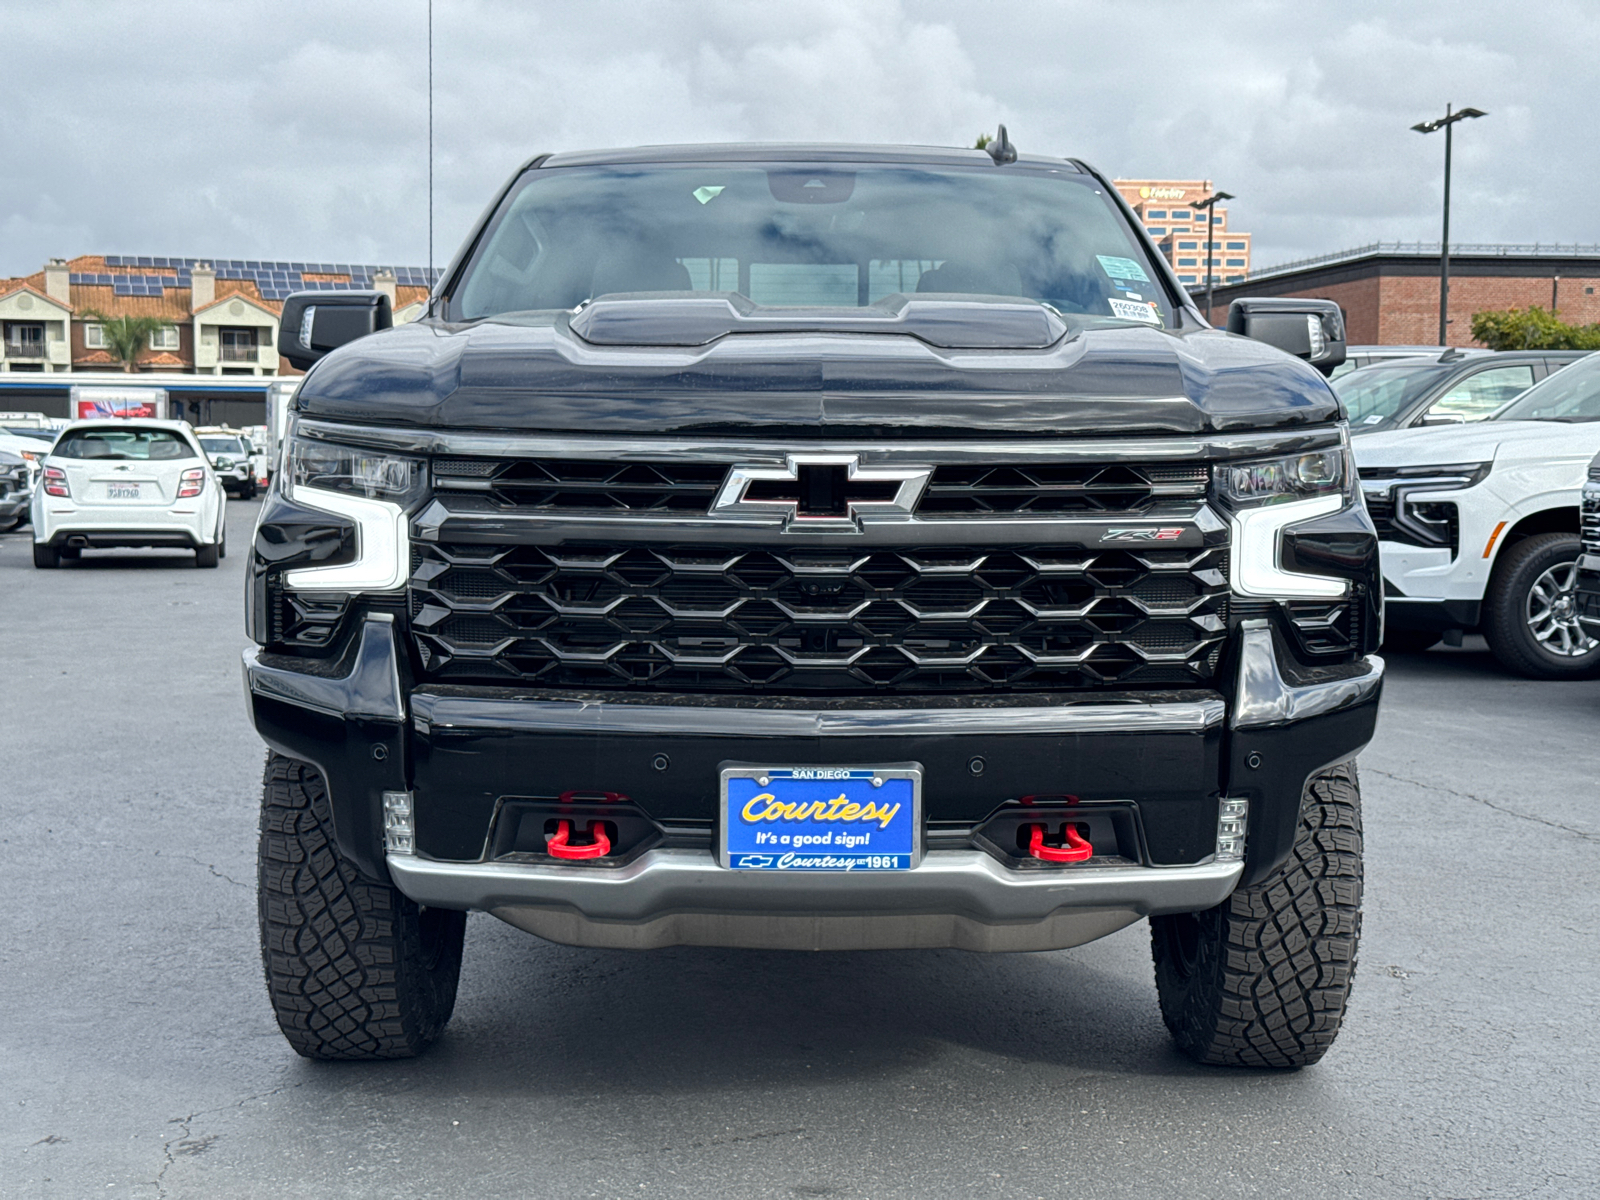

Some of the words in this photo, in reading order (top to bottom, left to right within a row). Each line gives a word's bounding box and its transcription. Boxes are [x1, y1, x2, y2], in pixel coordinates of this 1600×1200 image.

[1101, 527, 1186, 541] ZR2
[792, 770, 814, 779] SAN
[816, 770, 850, 779] DIEGO
[742, 793, 901, 828] Courtesy
[755, 832, 778, 844] It's
[780, 835, 790, 844] a
[793, 831, 832, 848] good
[834, 831, 870, 848] sign!
[777, 852, 856, 872] Courtesy
[865, 856, 898, 868] 1961
